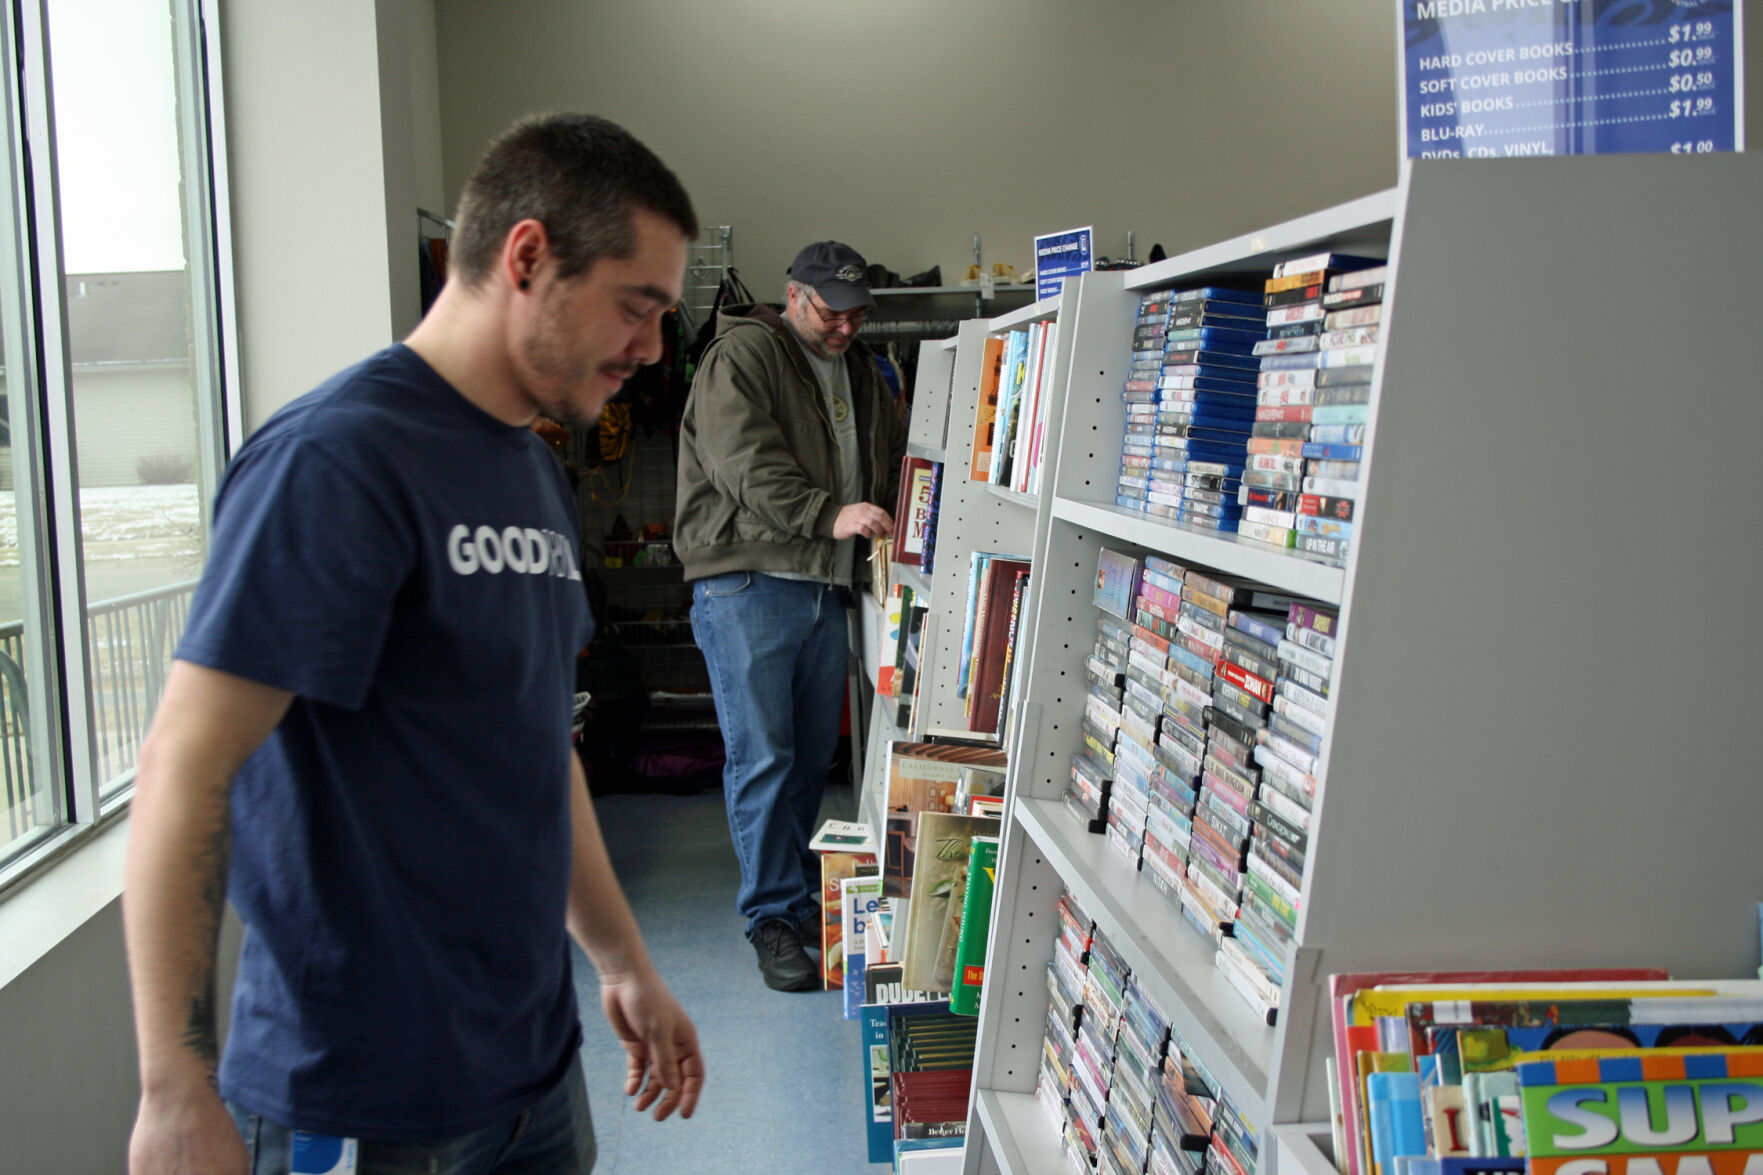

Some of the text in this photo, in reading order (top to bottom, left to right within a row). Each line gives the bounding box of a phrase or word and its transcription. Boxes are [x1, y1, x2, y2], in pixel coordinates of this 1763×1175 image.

[1417, 0, 1487, 20] MEDIA
[1420, 54, 1462, 70] HARD
[1466, 49, 1516, 66] COVER
[1519, 42, 1574, 60] BOOKS
[1668, 21, 1713, 44] $1.99
[1420, 46, 1713, 94] SOFT COVER BOOKS $0.99
[1420, 71, 1713, 118] KIDS' BOOKS $0.50
[1421, 97, 1713, 142] BLU-RAY $1.99
[875, 1031, 885, 1040] in
